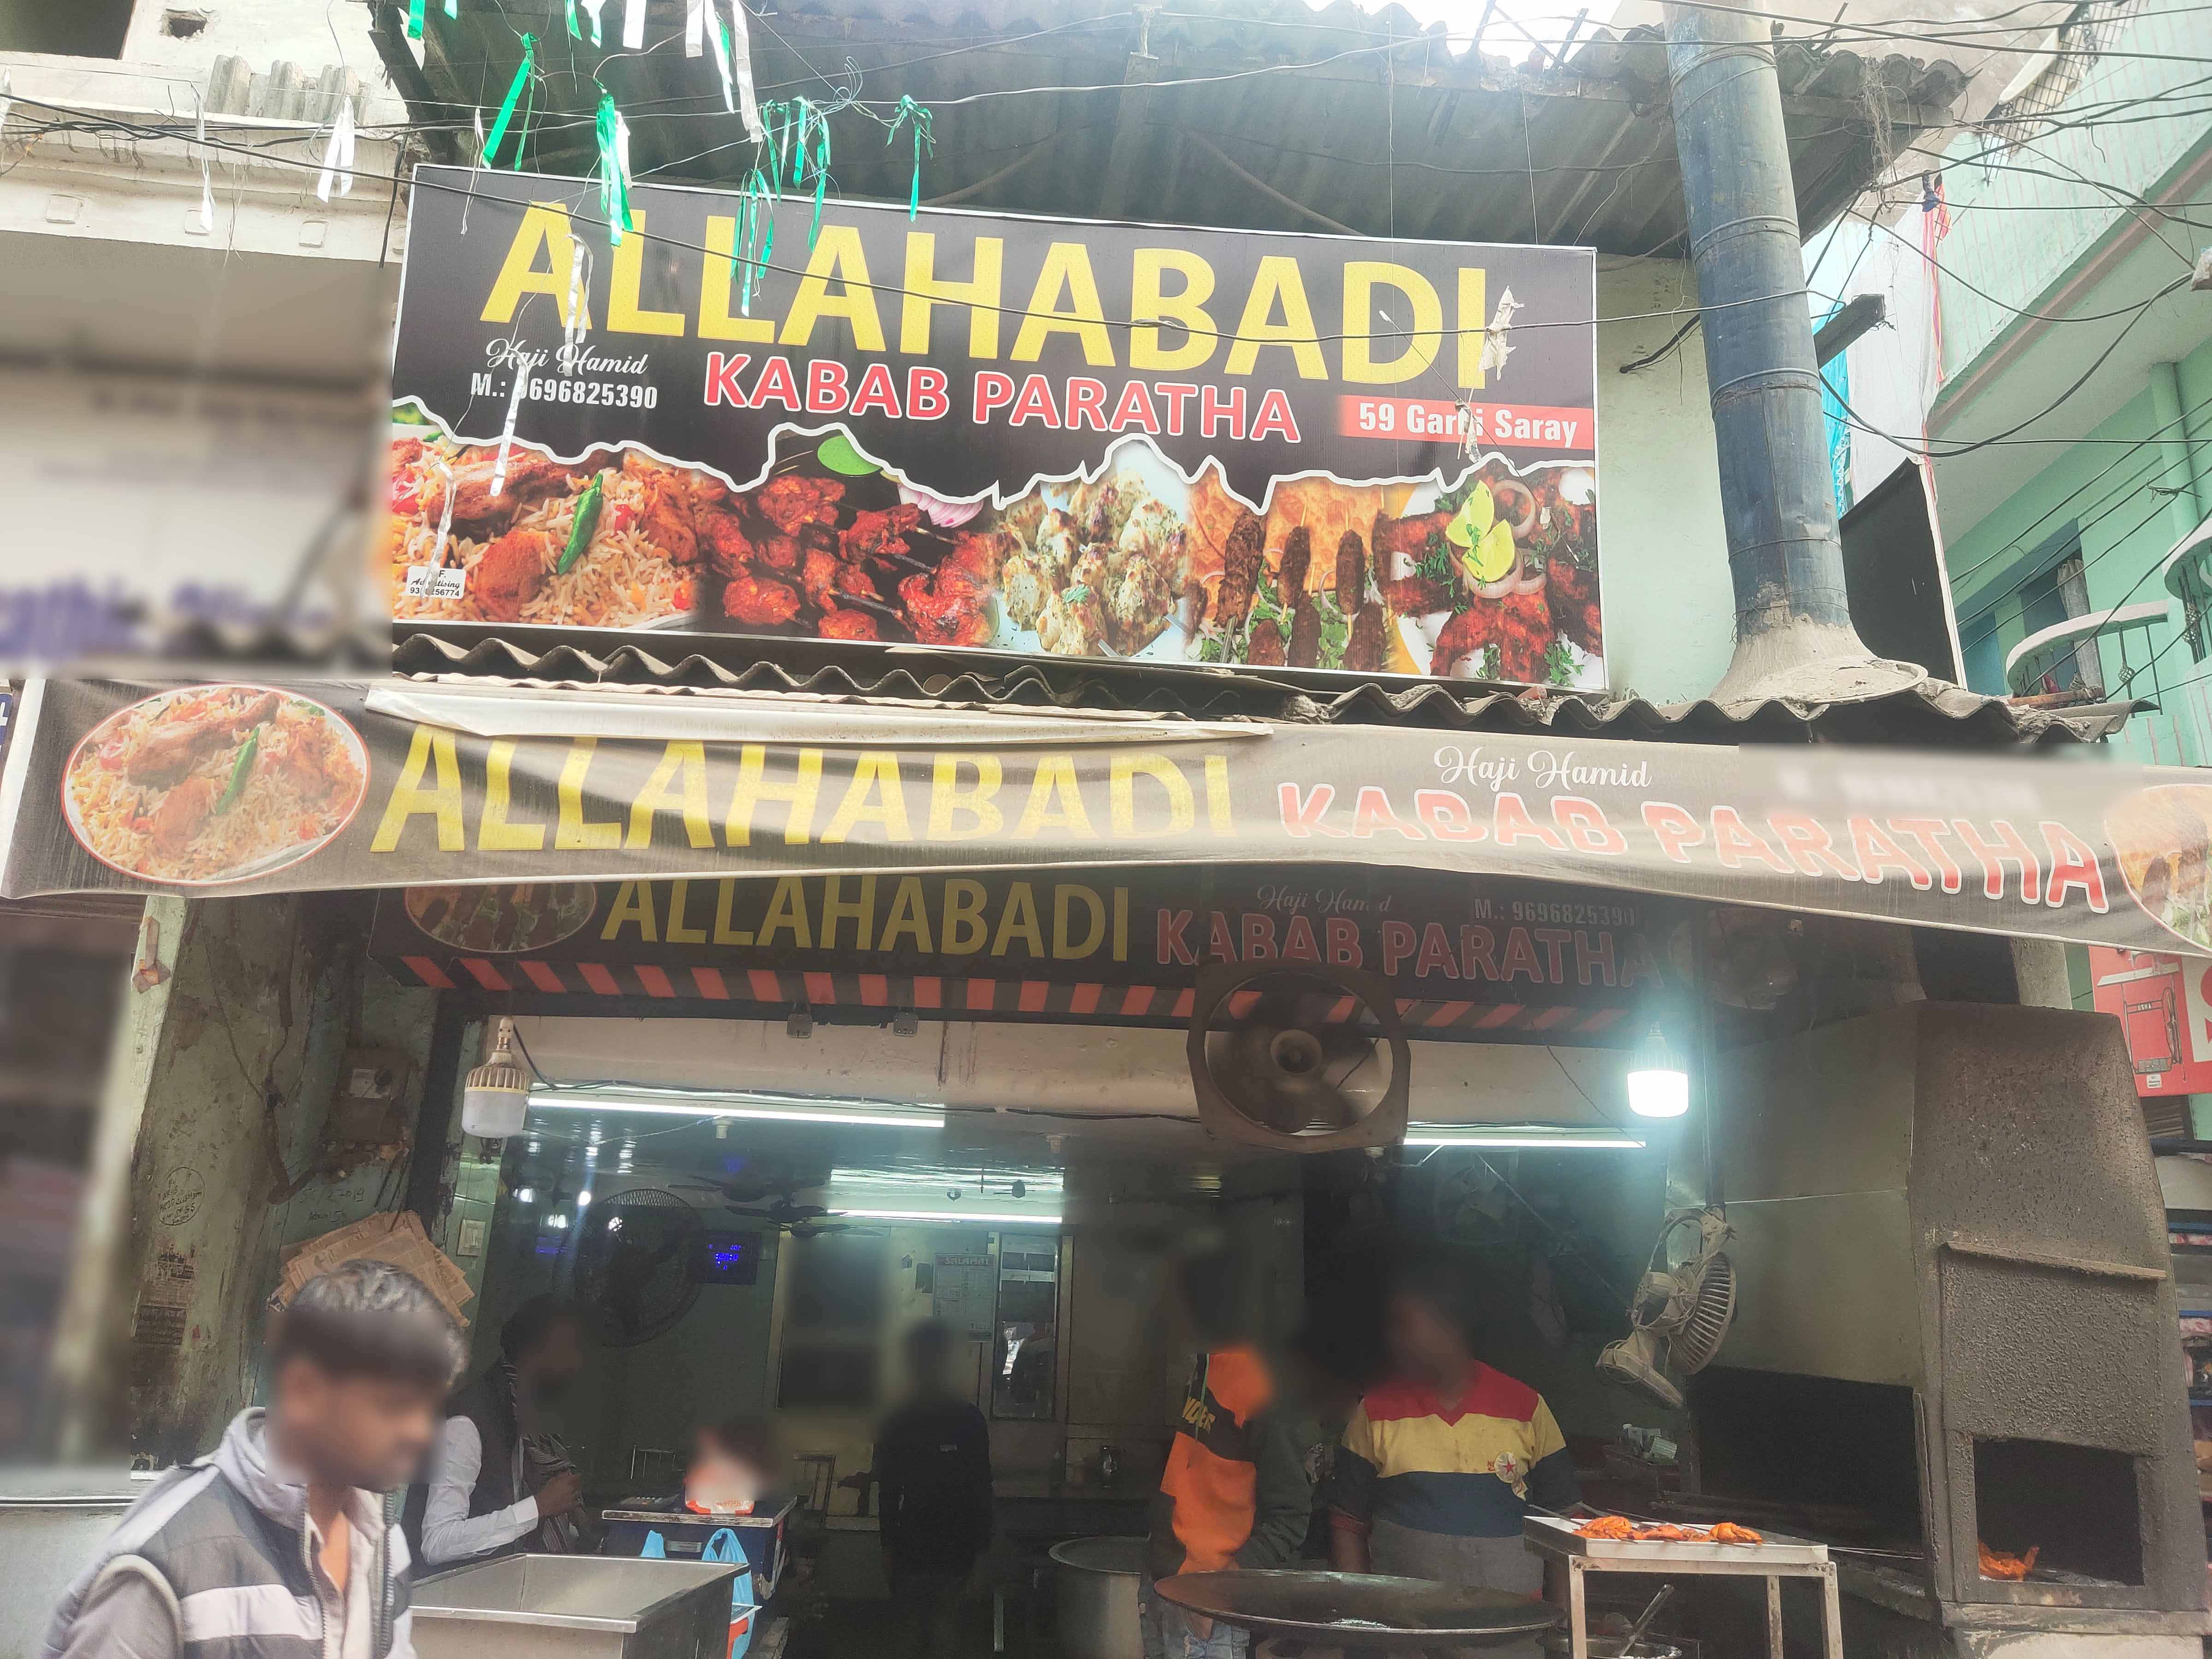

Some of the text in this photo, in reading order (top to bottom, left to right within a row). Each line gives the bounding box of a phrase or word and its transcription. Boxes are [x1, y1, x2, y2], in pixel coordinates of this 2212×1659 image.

[480, 201, 1486, 388] ALLAHABADI
[556, 344, 648, 376] Hamid
[515, 376, 658, 409] 696825390
[704, 351, 1302, 444] KABAB PARATHA
[1360, 402, 1394, 431] 59
[1495, 409, 1577, 448] Saray
[410, 587, 459, 597] 93256774
[411, 578, 460, 590] Adtising
[370, 724, 1238, 852] ALLAHABADI
[1434, 745, 1652, 793] Haji Hamid
[1277, 781, 2110, 914] KABAB PARATHA
[600, 875, 1129, 962] ALLAHABADI
[1256, 885, 1392, 915] Haji Hamd
[1511, 900, 1635, 926] 9696825390
[1155, 908, 1665, 988] KABAB PARATHA
